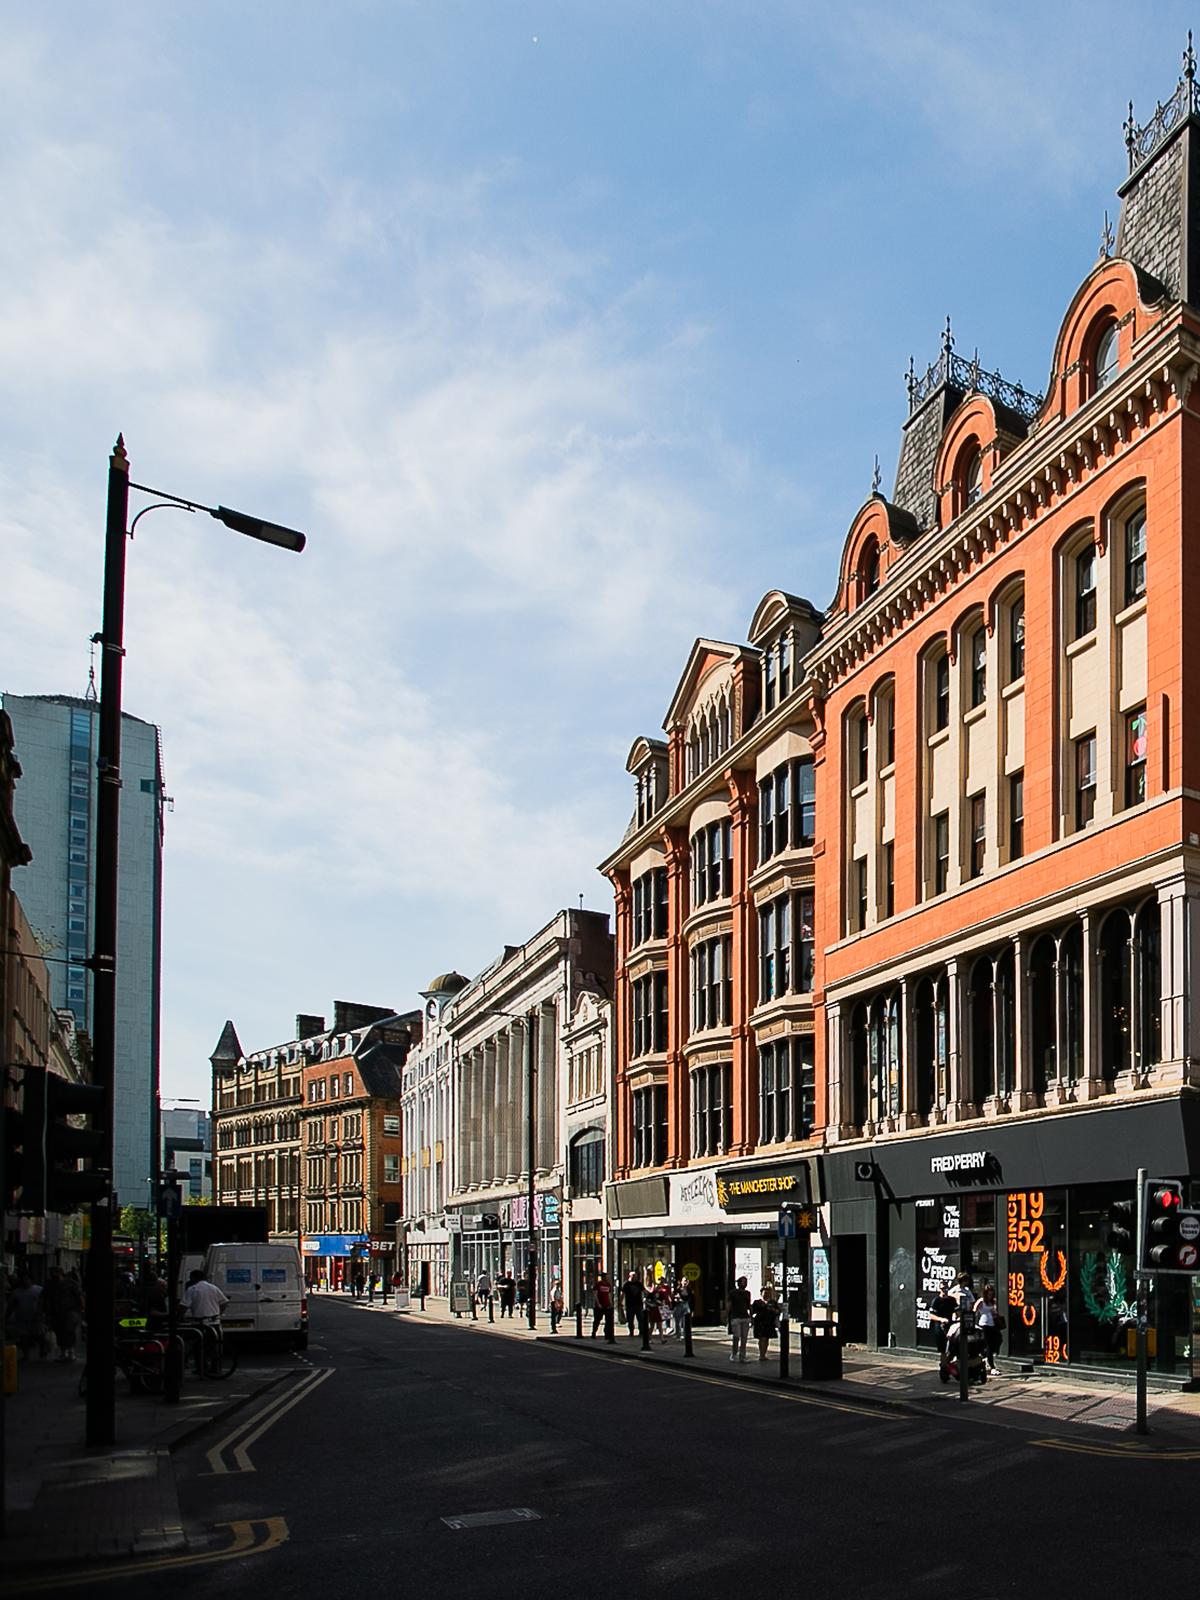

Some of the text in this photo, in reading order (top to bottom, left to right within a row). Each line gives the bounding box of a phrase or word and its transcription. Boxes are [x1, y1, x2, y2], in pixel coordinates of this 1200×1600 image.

[931, 1151, 986, 1173] FRED PERRY
[730, 1176, 795, 1195] THE MANCHESTER SHOP
[1017, 1192, 1044, 1219] 19
[950, 1218, 960, 1228] FR
[1017, 1221, 1045, 1252] 52
[371, 1241, 396, 1251] BET
[931, 1265, 956, 1280] FRED
[923, 1278, 953, 1292] PER
[1047, 1336, 1060, 1350] 19
